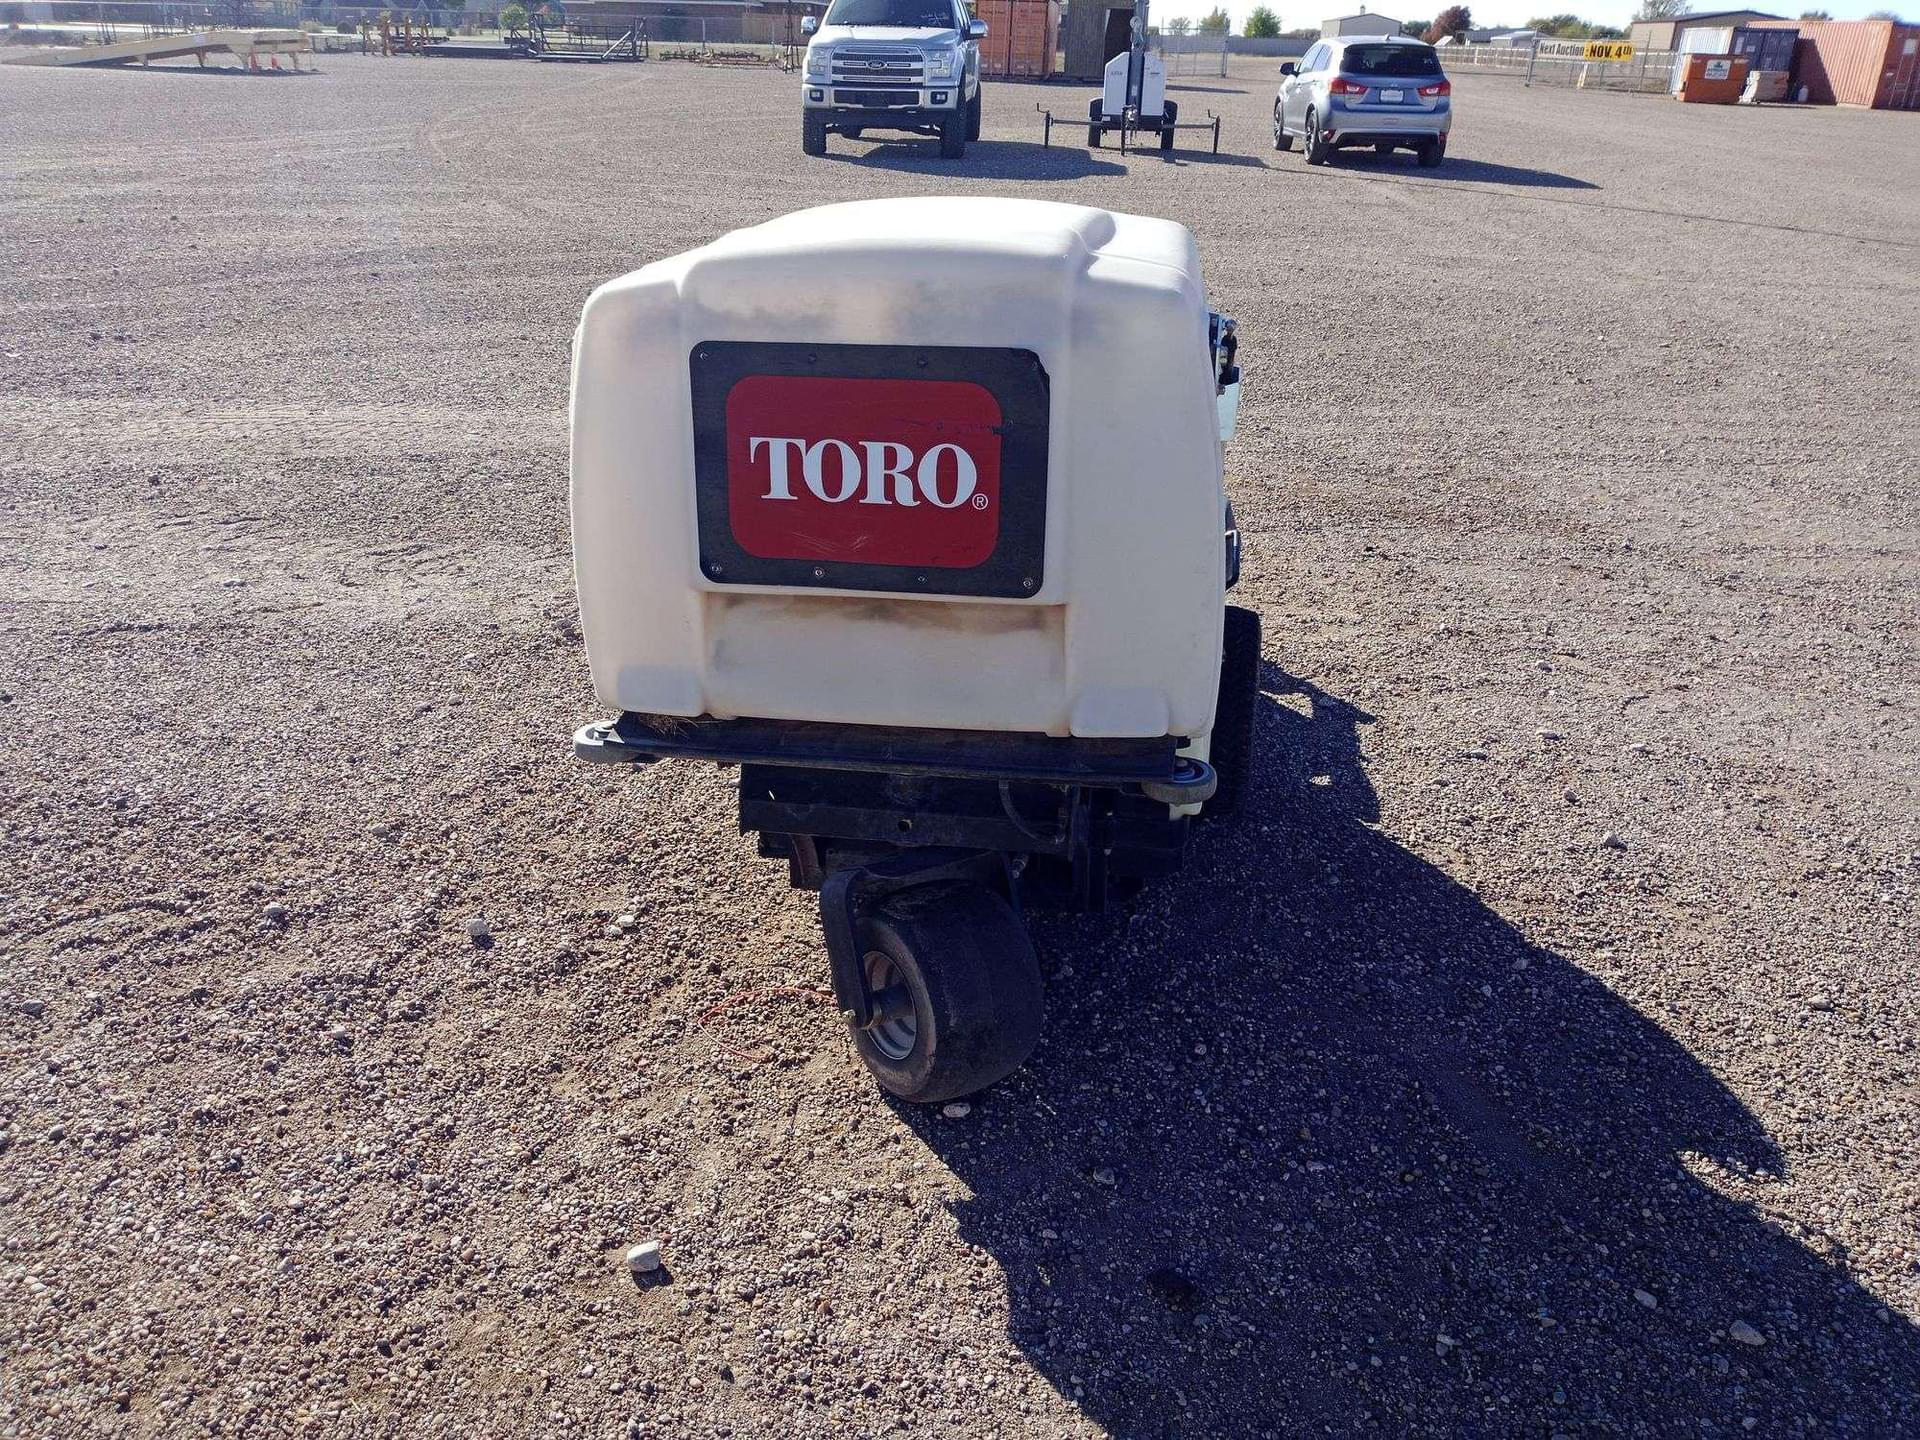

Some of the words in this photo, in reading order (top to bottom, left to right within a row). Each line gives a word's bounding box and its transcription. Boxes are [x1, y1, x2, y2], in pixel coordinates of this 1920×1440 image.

[1540, 42, 1555, 54] Next
[1589, 45, 1613, 58] NOV.
[1615, 46, 1633, 59] 4th
